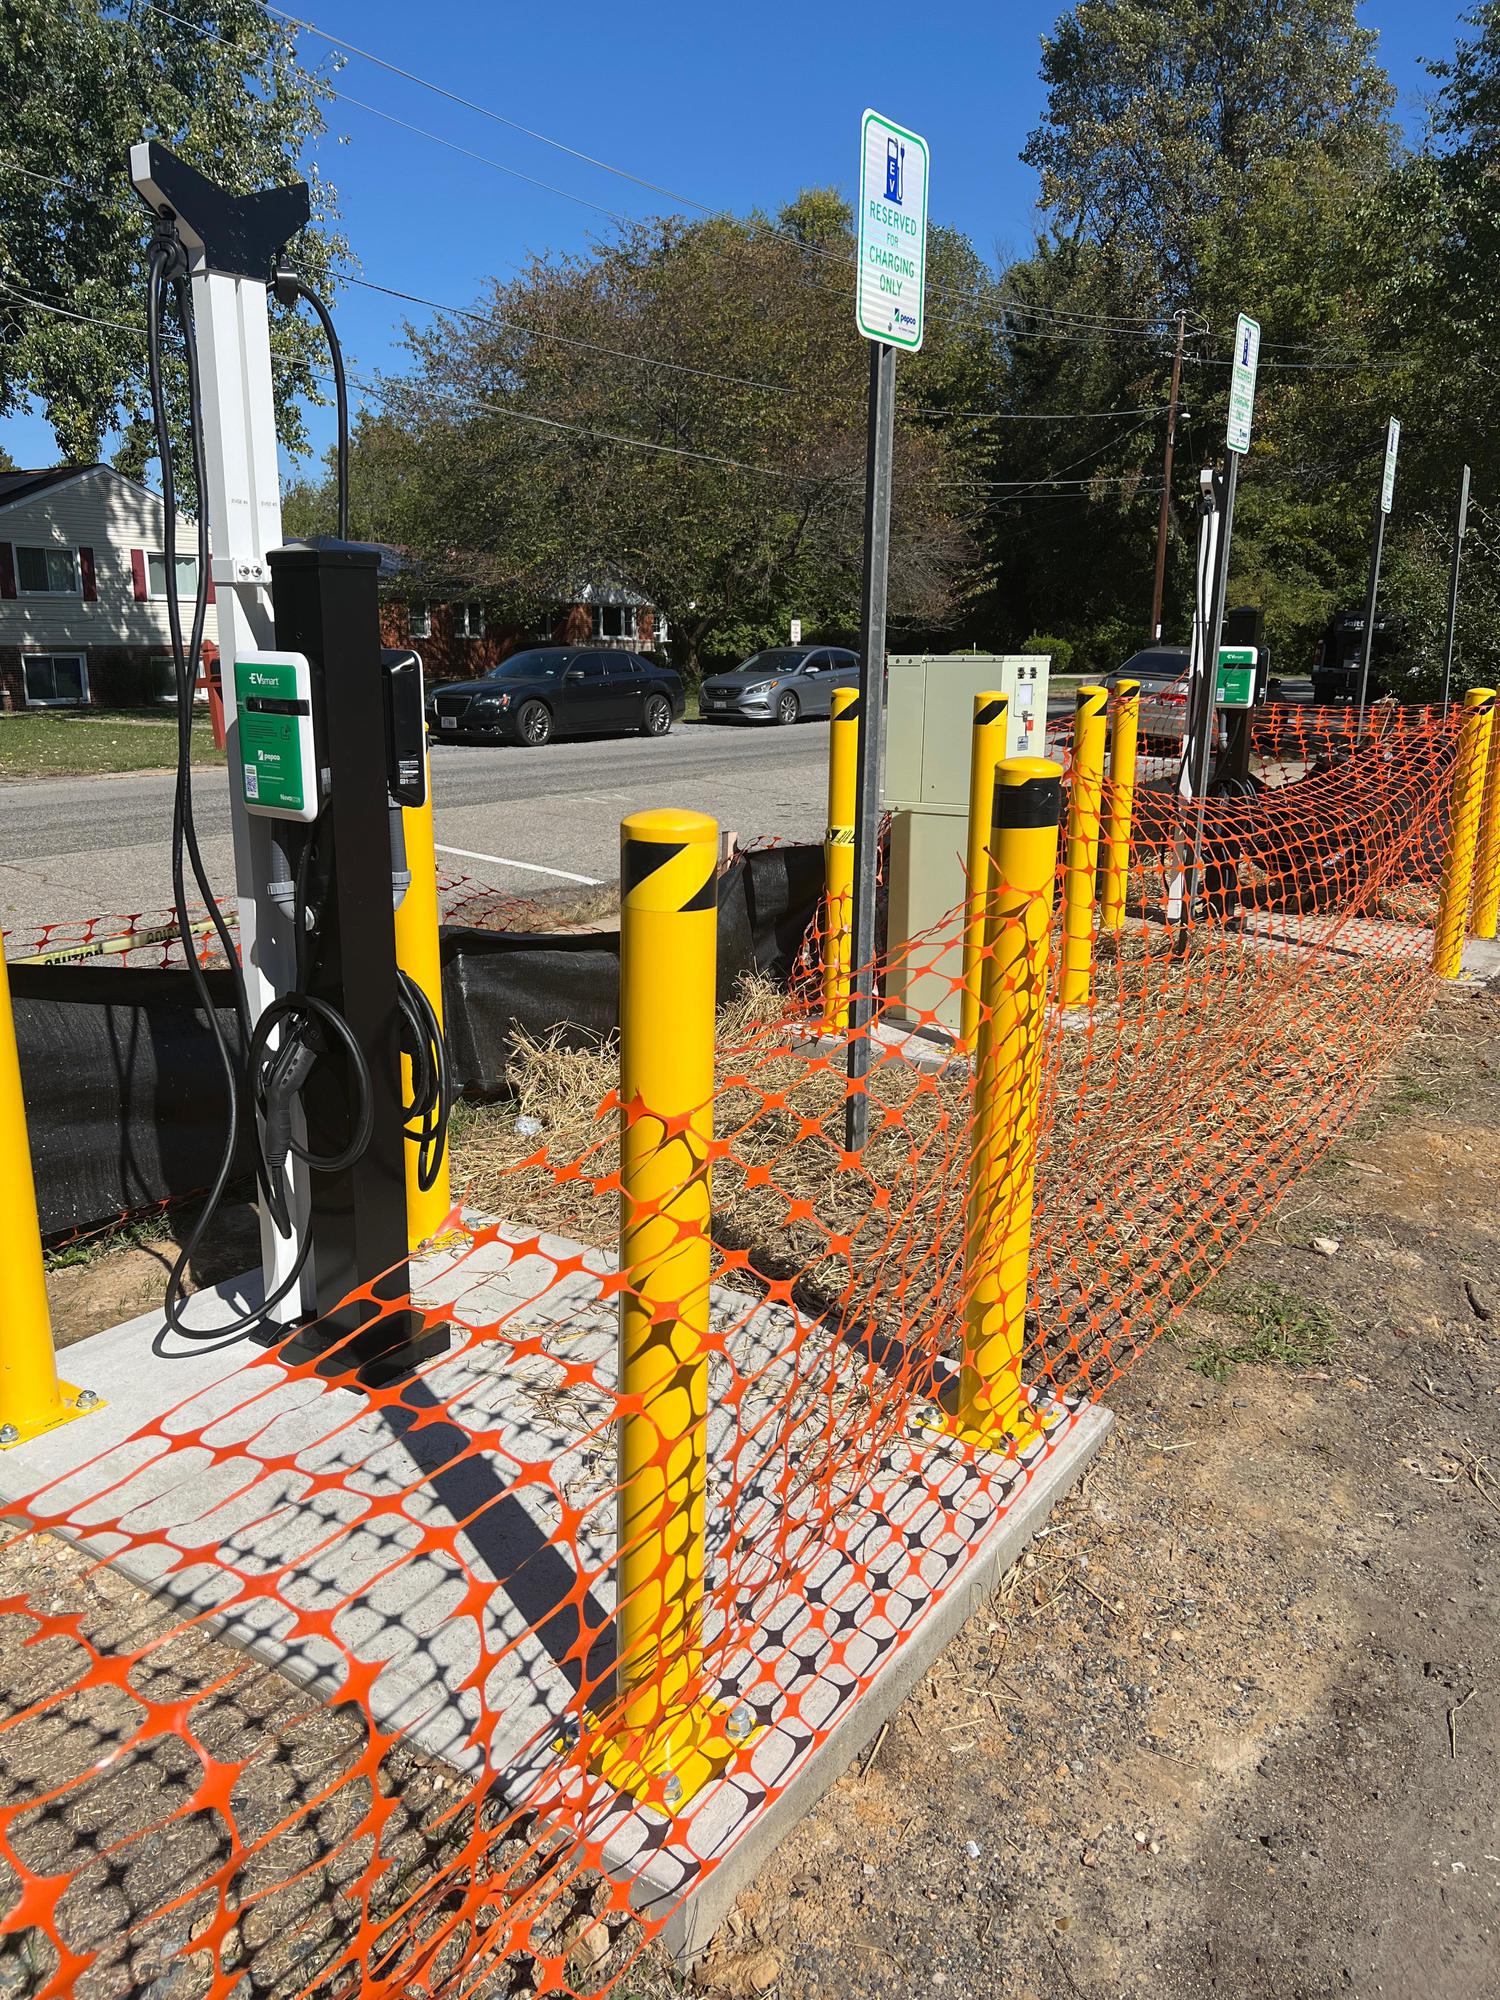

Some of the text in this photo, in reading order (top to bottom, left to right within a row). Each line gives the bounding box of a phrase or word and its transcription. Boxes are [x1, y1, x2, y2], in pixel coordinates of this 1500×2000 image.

[869, 200, 917, 237] RESERVED
[886, 232, 899, 249] FOR
[869, 245, 915, 279] CHARGING
[879, 272, 903, 297] ONLY
[900, 314, 916, 326] pepco
[249, 672, 280, 686] EVsmart
[264, 753, 280, 762] pepco
